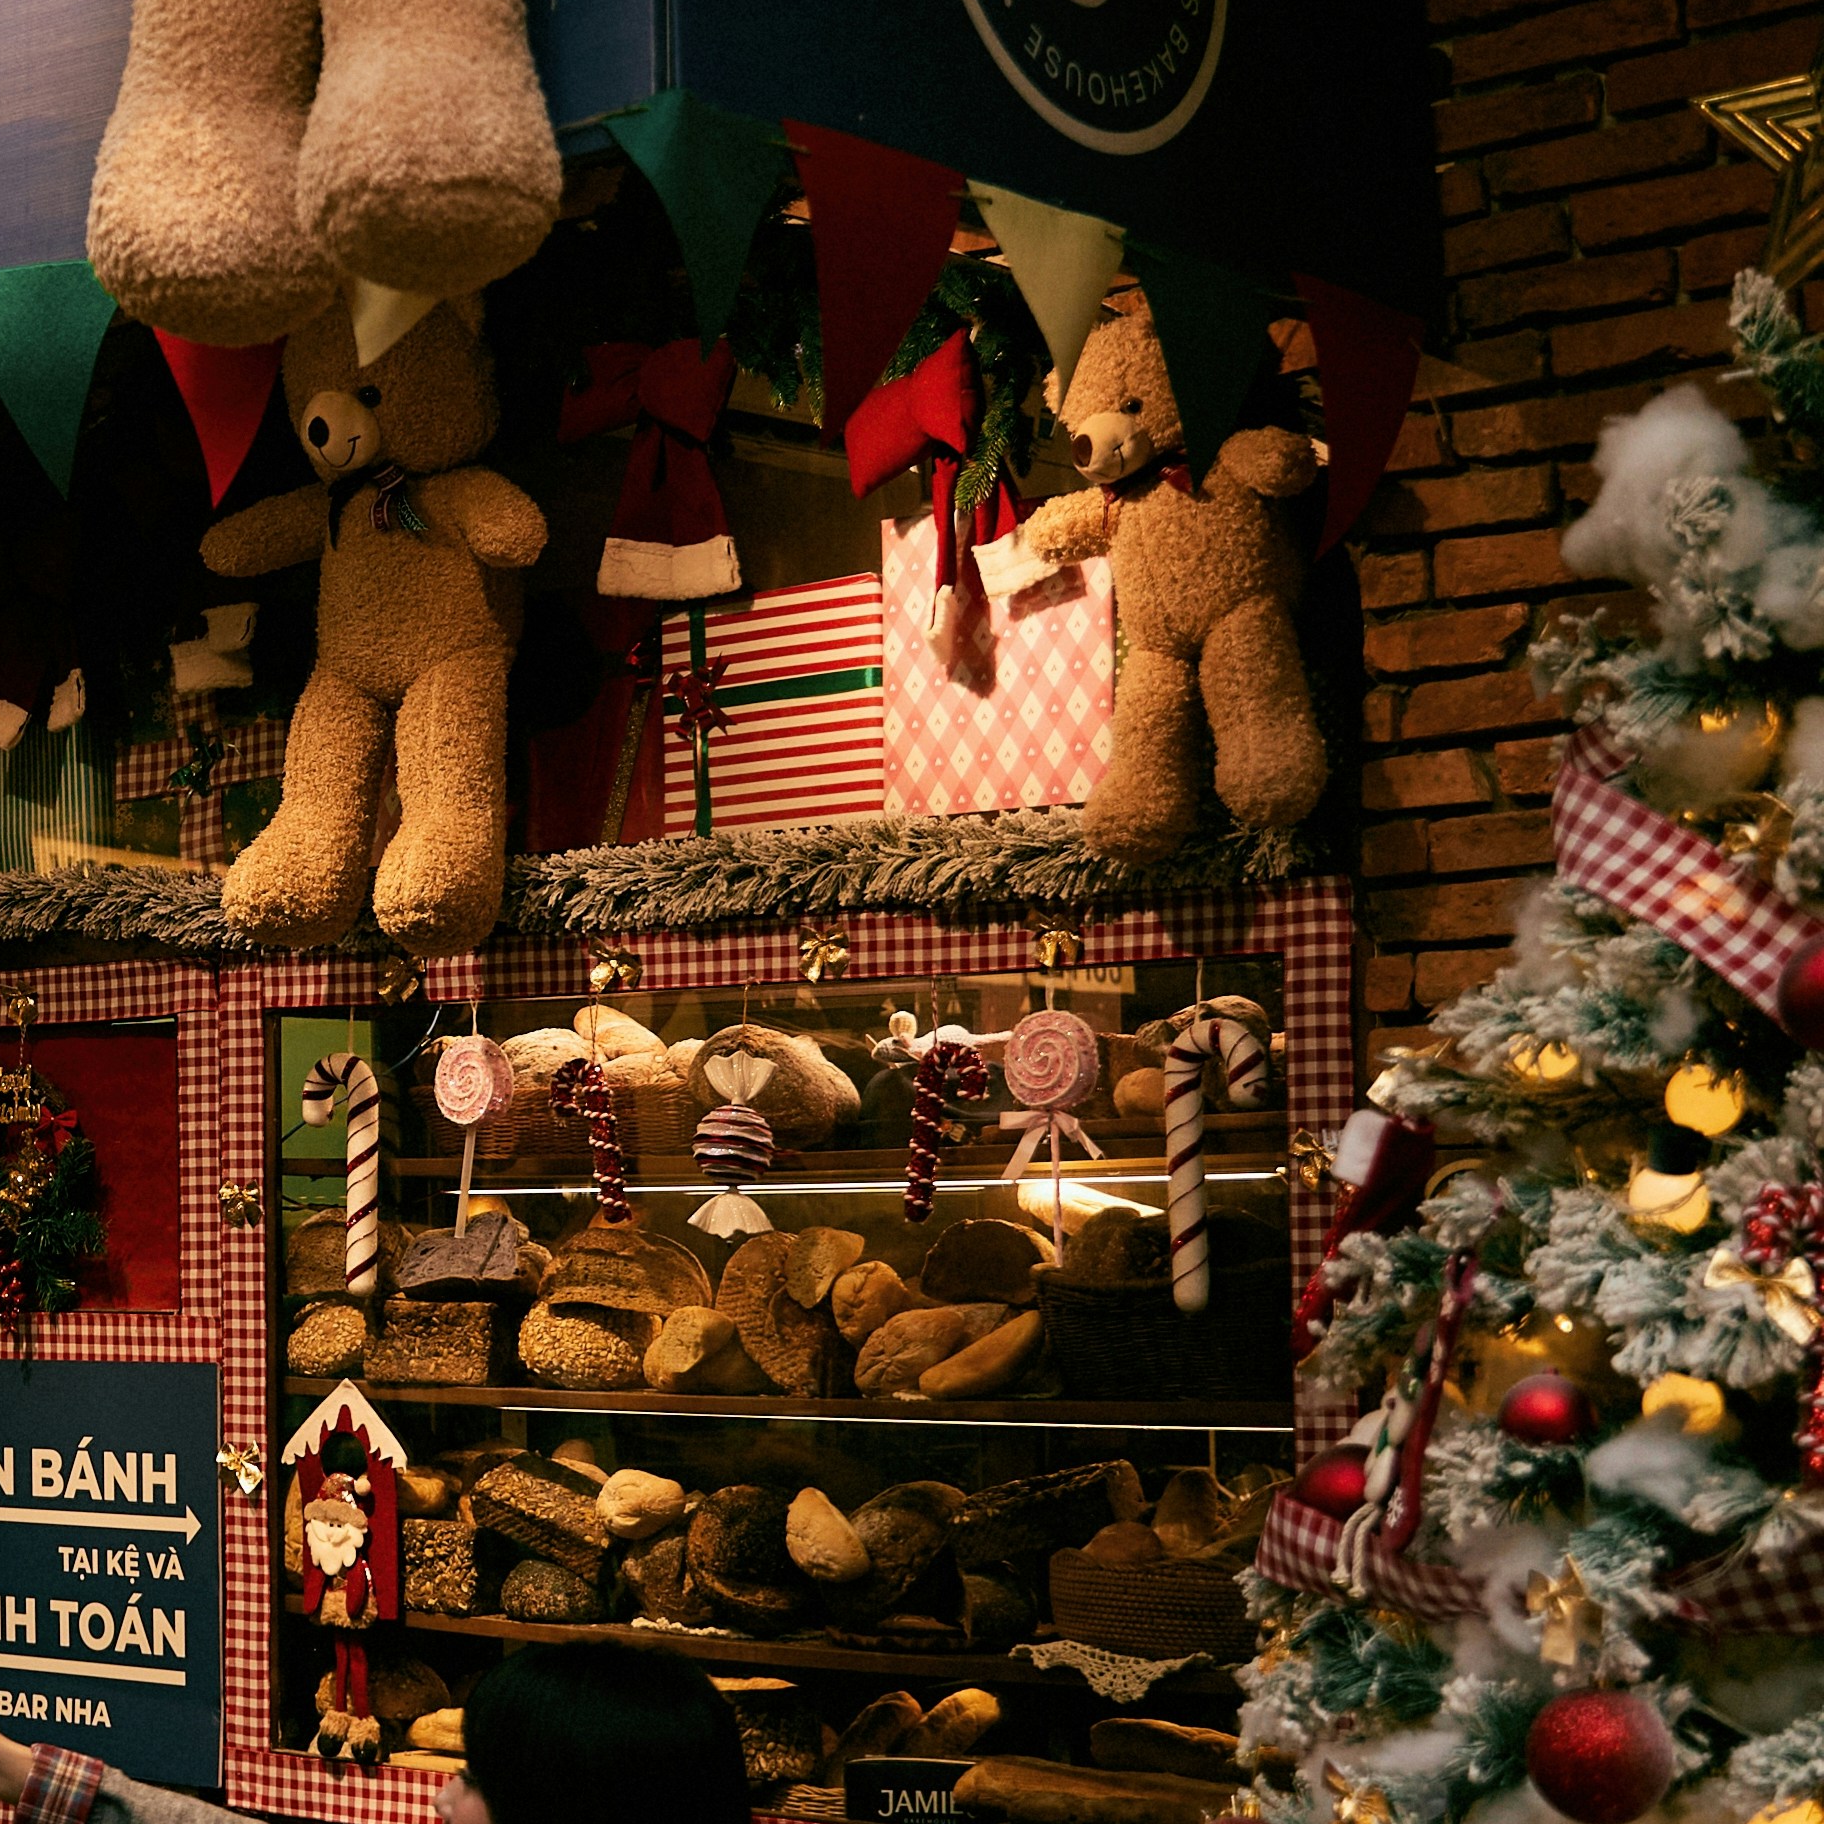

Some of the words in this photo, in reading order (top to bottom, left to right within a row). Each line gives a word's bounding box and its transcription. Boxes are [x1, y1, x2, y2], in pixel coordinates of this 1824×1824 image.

[1023, 23, 1190, 108] BAKEHOUSE
[31, 1436, 177, 1504] BÁNH
[58, 1546, 99, 1581] TẠI
[106, 1544, 140, 1585] KỆ
[146, 1546, 185, 1581] VÀ
[49, 1593, 186, 1658] TOÁN
[55, 1696, 112, 1728] NHA
